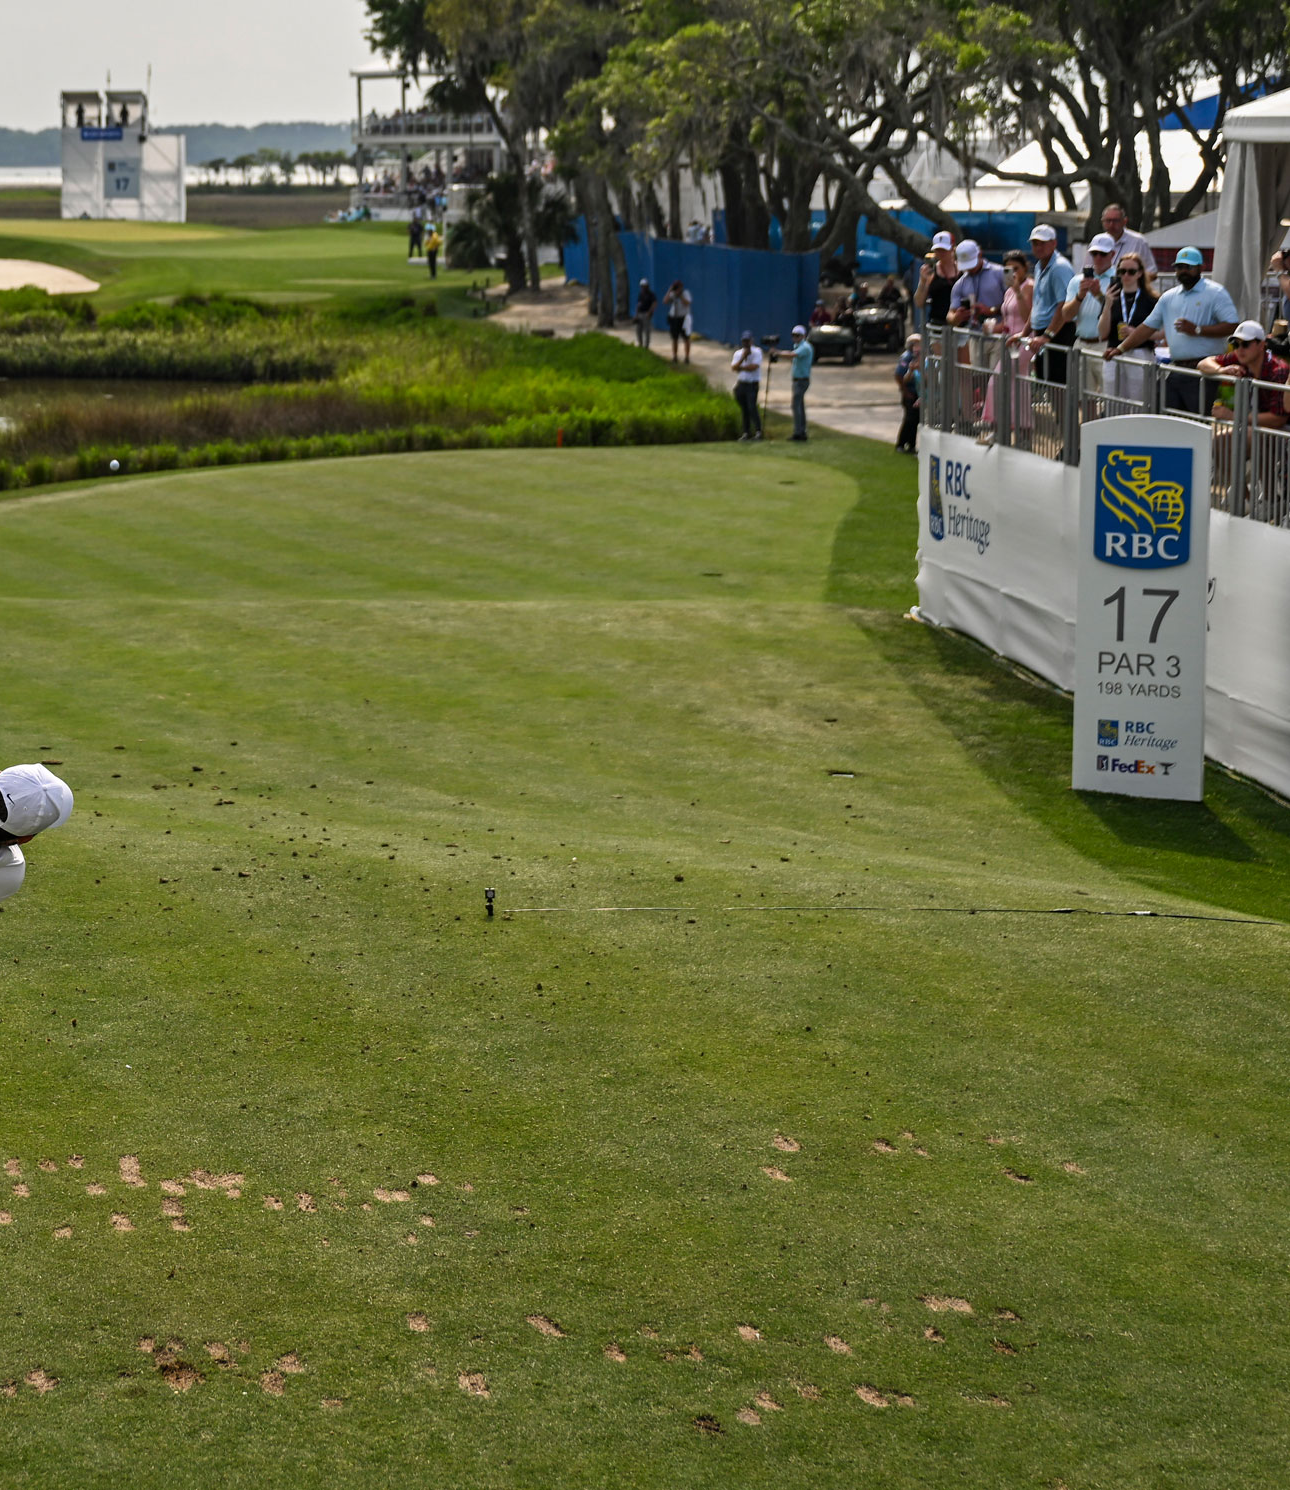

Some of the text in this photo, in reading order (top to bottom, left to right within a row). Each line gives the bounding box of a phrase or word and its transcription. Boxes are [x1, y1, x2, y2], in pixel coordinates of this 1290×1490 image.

[115, 178, 130, 191] 17
[945, 460, 972, 500] RBC
[947, 504, 990, 555] Heritage
[1104, 532, 1179, 560] RBC
[1103, 585, 1180, 644] 17
[1097, 651, 1181, 678] PAR 3
[1097, 681, 1181, 699] 198 YARDS
[1124, 721, 1156, 735] RBC
[1099, 738, 1116, 746] RBC
[1123, 735, 1179, 751] Heritage
[1111, 758, 1156, 774] FedEx
